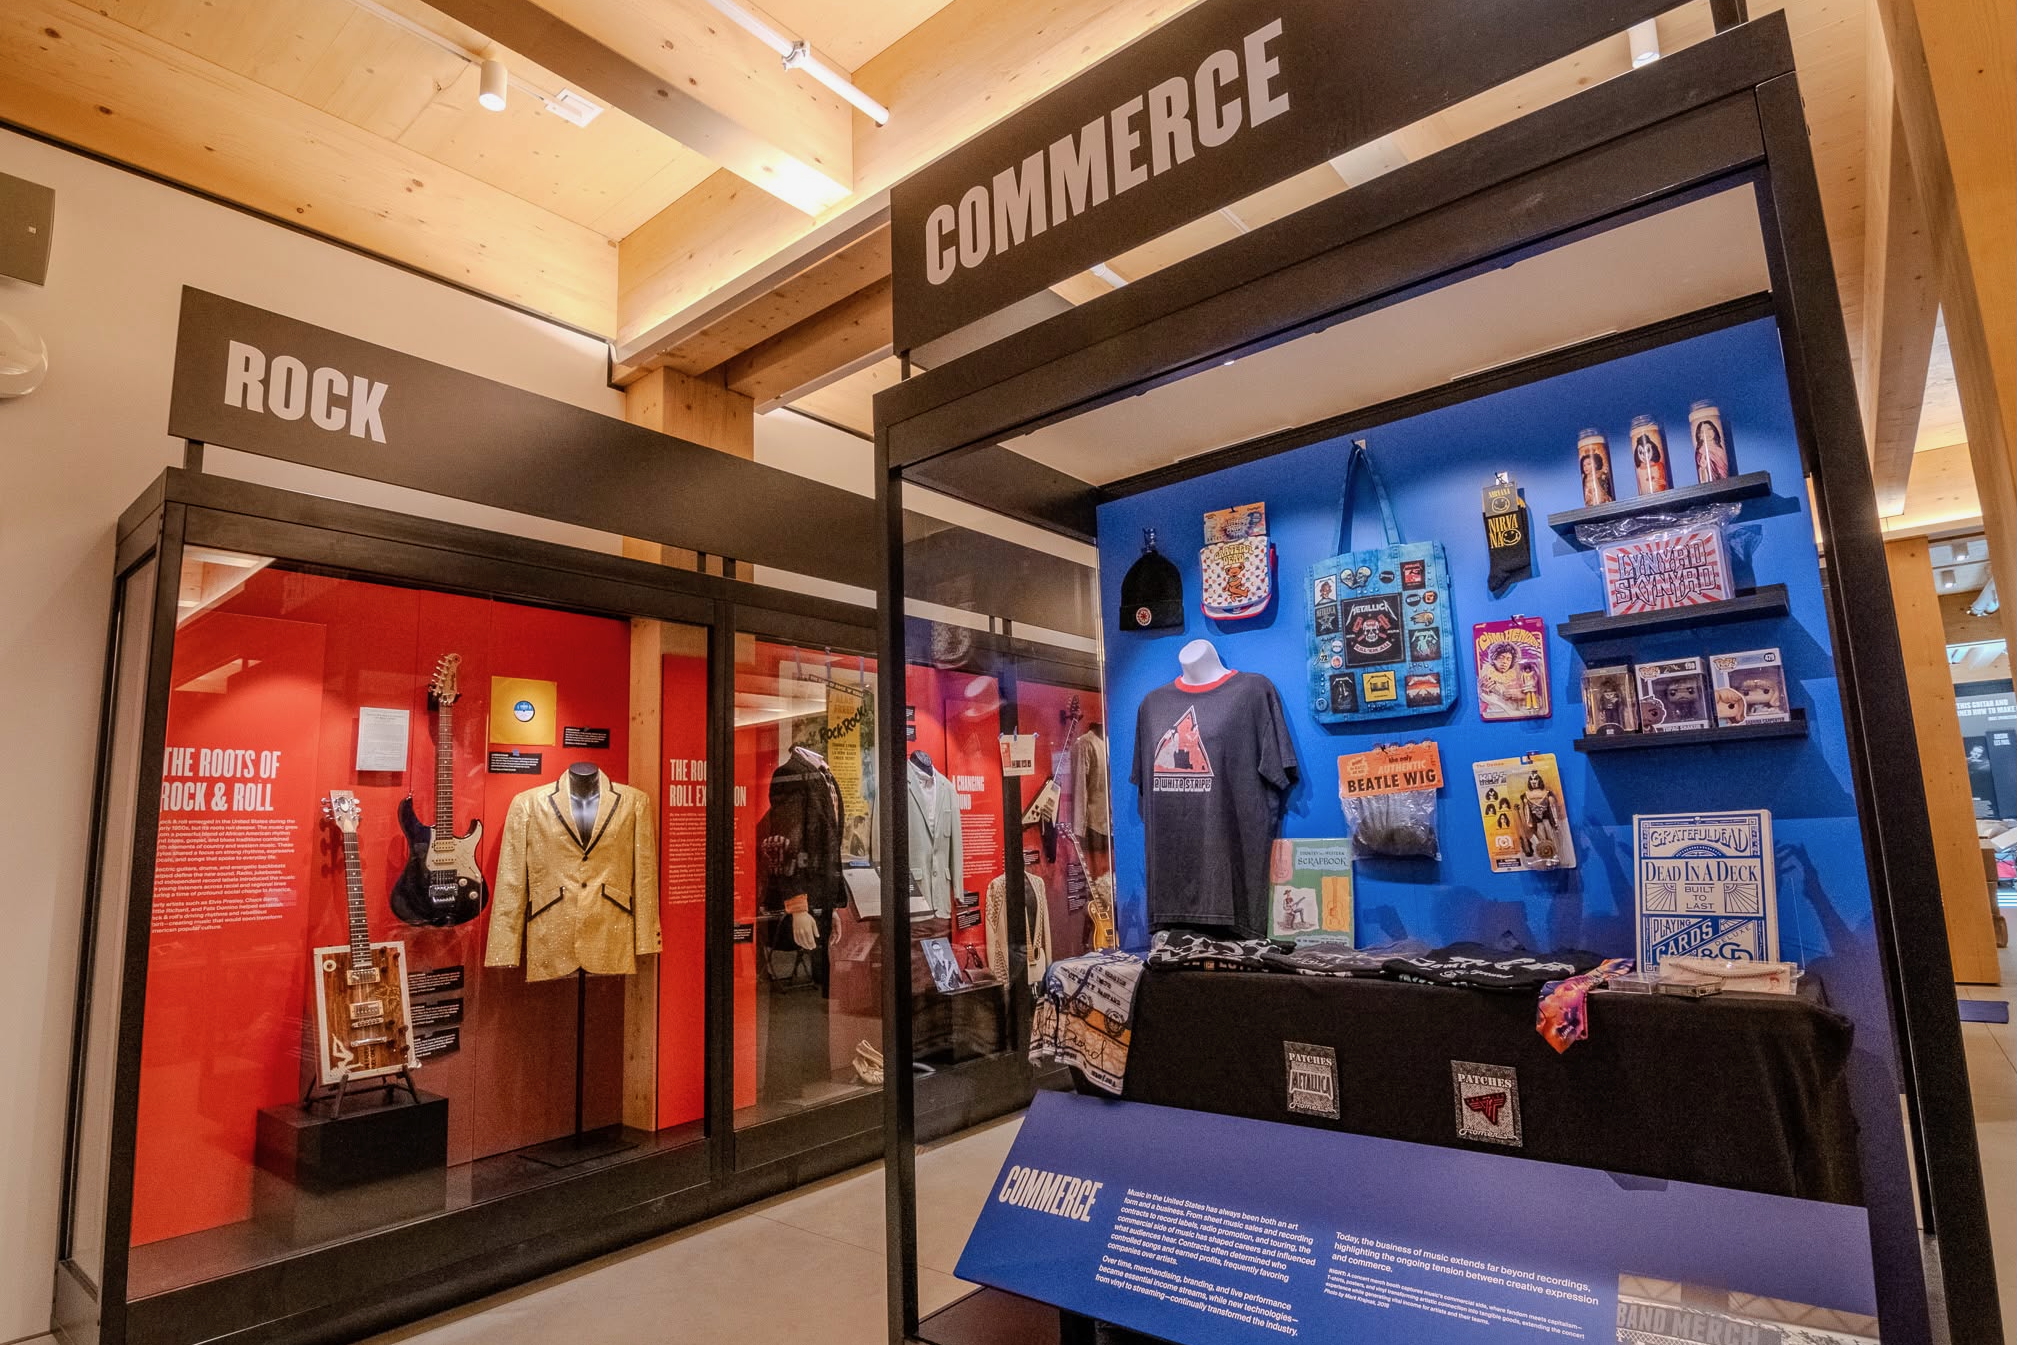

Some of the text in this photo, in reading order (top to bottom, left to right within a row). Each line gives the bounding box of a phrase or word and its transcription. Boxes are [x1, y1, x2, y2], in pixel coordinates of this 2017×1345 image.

[925, 17, 1290, 285] COMMERCE
[224, 339, 389, 444] ROCK
[1488, 514, 1519, 533] NIRVA
[1490, 531, 1504, 549] NA
[1223, 553, 1244, 565] DEAD
[1617, 538, 1707, 579] LYNYRD
[1614, 565, 1717, 607] SKYNYRD
[163, 747, 281, 778] THE ROOTS OF
[670, 759, 688, 781] THE
[1378, 759, 1426, 775] AUTHENTIC
[1389, 755, 1400, 763] the
[1347, 768, 1436, 793] BEATLE WIG
[211, 782, 228, 811] &
[233, 783, 274, 811] ROLL
[669, 785, 694, 807] ROLL
[1650, 827, 1749, 853] GRATEFUL DEAD
[1297, 857, 1348, 867] SCRAPBOOK
[1645, 860, 1758, 881] DEAD IN A DECK
[1684, 886, 1714, 894] BUILT
[1686, 902, 1714, 910] LAST
[1653, 918, 1691, 941] PLAYING
[1656, 921, 1714, 963] CARDS
[1714, 926, 1752, 947] DELUXE
[1289, 1052, 1332, 1066] PATCHES
[1457, 1073, 1512, 1088] PATCHES
[998, 1166, 1103, 1223] COMMERCE
[1126, 1188, 1145, 1198] Music
[1150, 1193, 1163, 1202] the
[1162, 1195, 1184, 1206] United
[1183, 1200, 1206, 1211] States
[1204, 1204, 1218, 1213] has
[1217, 1207, 1242, 1220] always
[1240, 1212, 1260, 1222] been
[1259, 1215, 1277, 1225] both
[1287, 1221, 1299, 1230] art
[1119, 1206, 1150, 1218] contracts
[1155, 1213, 1178, 1224] record
[1176, 1218, 1199, 1231] labels,
[1198, 1223, 1218, 1233] radio
[1216, 1227, 1255, 1243] promotion,
[1254, 1235, 1270, 1244] and
[1268, 1238, 1298, 1253] touring,
[1297, 1244, 1312, 1254] the
[1123, 1197, 1139, 1206] form
[1137, 1200, 1152, 1209] and
[1154, 1203, 1185, 1216] business.
[1184, 1210, 1204, 1220] From
[1202, 1213, 1223, 1224] sheet
[1222, 1218, 1244, 1228] music
[1243, 1222, 1264, 1233] sales
[1262, 1226, 1278, 1236] and
[1277, 1230, 1314, 1245] recording
[1106, 1241, 1178, 1265] companies over artists.
[1113, 1224, 1287, 1269] what audiences hear. Contracts often determined who
[1116, 1214, 1154, 1229] commercial
[1152, 1222, 1168, 1232] side
[1173, 1227, 1195, 1238] music
[1194, 1232, 1209, 1241] has
[1206, 1234, 1234, 1248] shaped
[1233, 1242, 1261, 1253] careers
[1261, 1246, 1276, 1256] and
[1276, 1250, 1316, 1265] influenced
[1110, 1232, 1290, 1282] controlled songs and earned profits, frequently favoring
[1331, 1253, 1392, 1272] and commerce.
[1335, 1231, 1360, 1245] Today,
[1360, 1237, 1374, 1246] the
[1375, 1240, 1412, 1254] business
[1422, 1250, 1449, 1261] music
[1449, 1255, 1485, 1269] extends
[1486, 1263, 1499, 1272] far
[1499, 1266, 1535, 1281] beyond
[1535, 1273, 1592, 1293] recordings,
[1101, 1254, 1292, 1311] Over time, merchandising, branding, and live performance
[1333, 1243, 1600, 1305] highlighting the ongoing tension between creative expression
[1094, 1273, 1111, 1284] from
[1108, 1277, 1126, 1290] vinyl
[1131, 1283, 1208, 1312] streaming—continually
[1206, 1304, 1252, 1322] transformed
[1251, 1316, 1266, 1326] the
[1264, 1320, 1298, 1337] industry.
[1097, 1265, 1298, 1325] became essential income streams, while new technologies—
[1616, 1303, 1759, 1345] BAND MERCH
